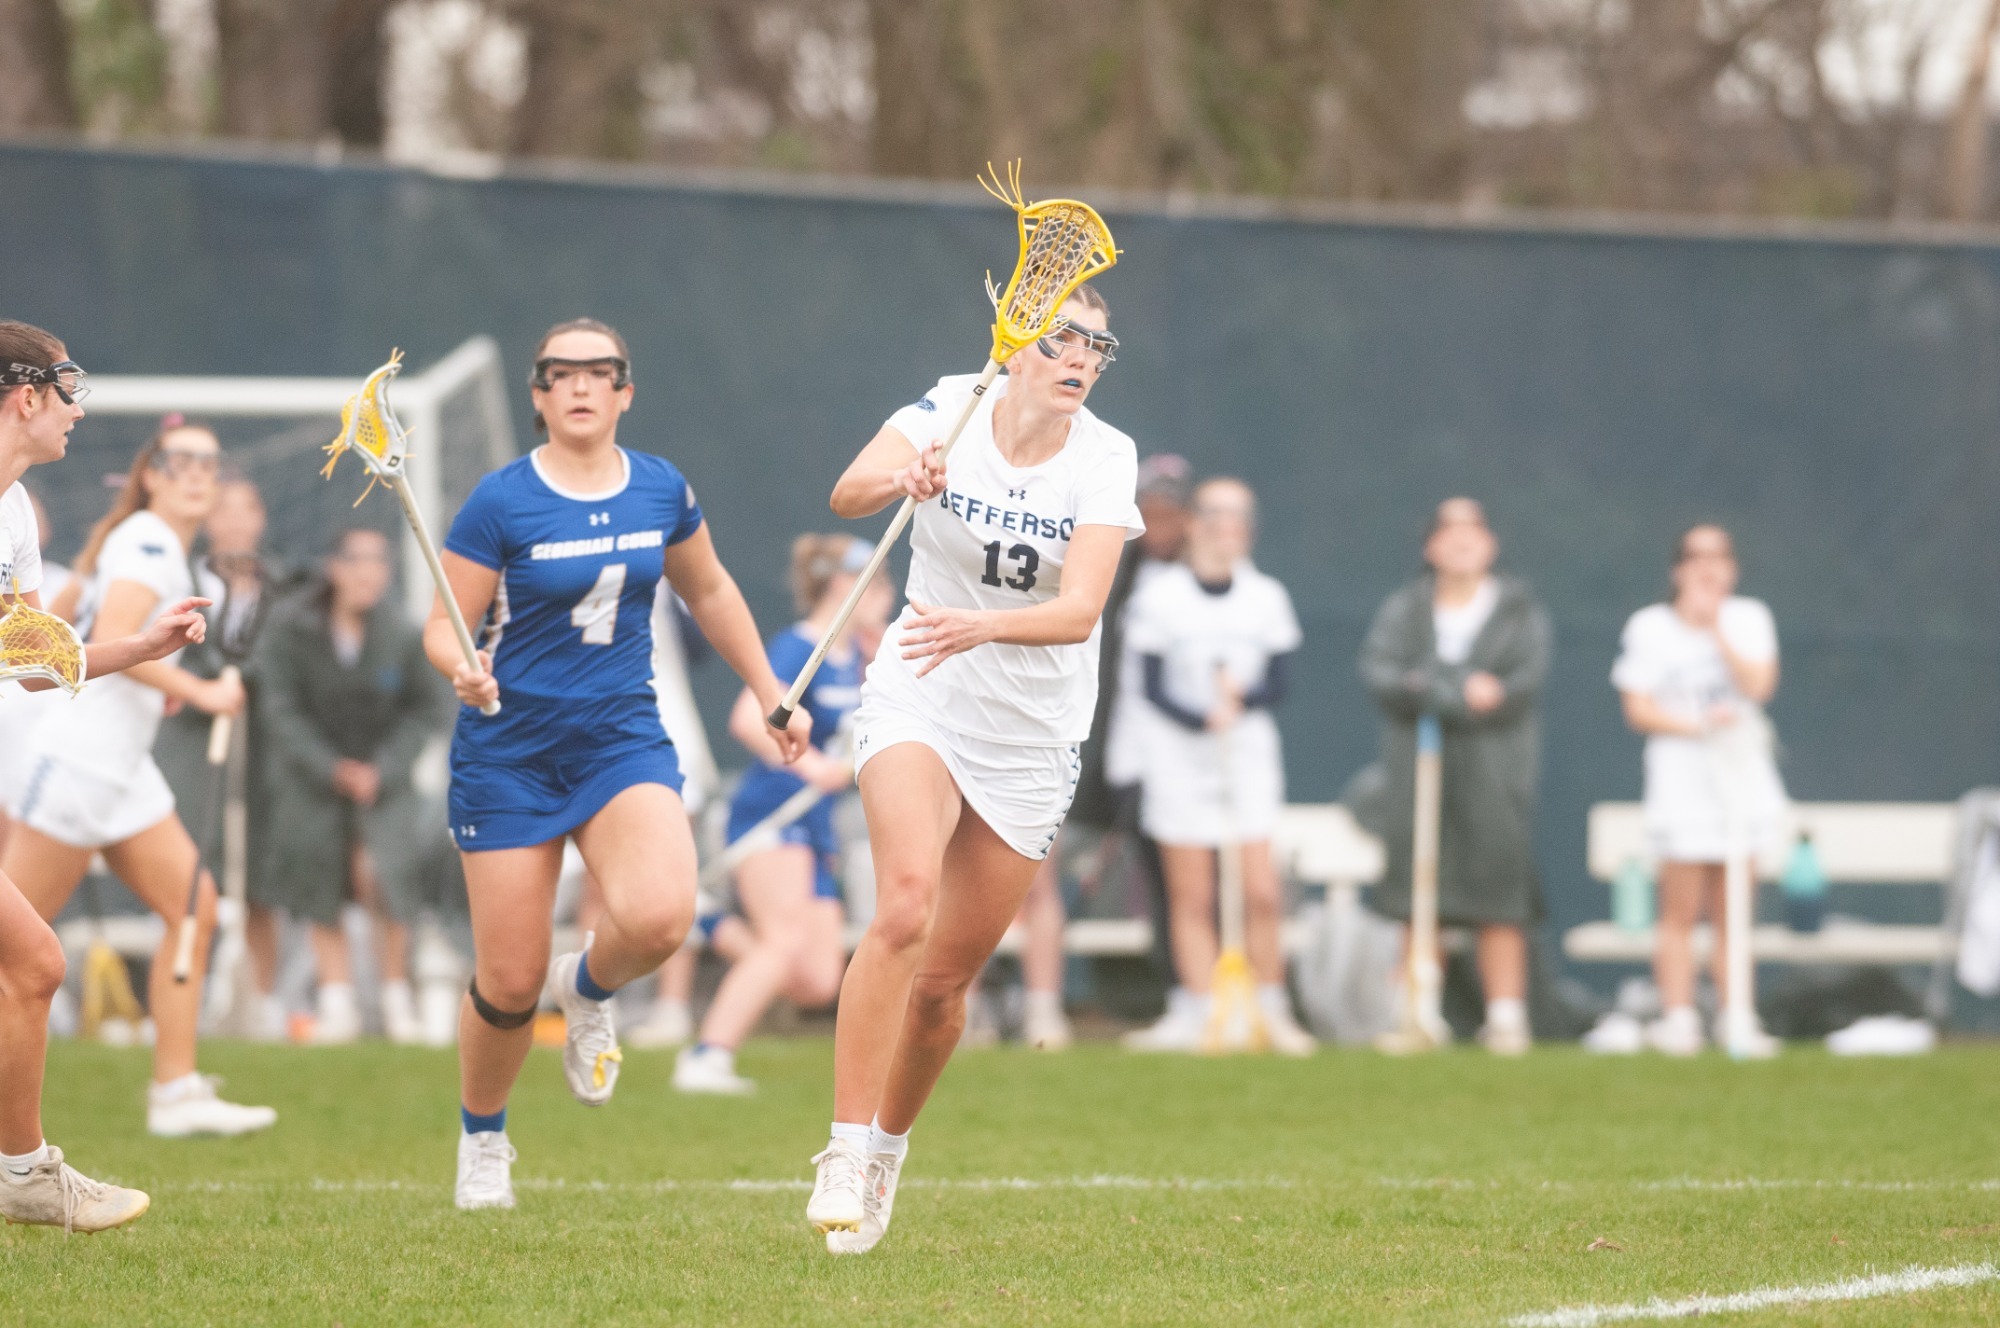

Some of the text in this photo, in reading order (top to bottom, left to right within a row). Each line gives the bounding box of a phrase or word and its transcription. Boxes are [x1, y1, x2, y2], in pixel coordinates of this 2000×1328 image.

[9, 362, 47, 378] STX
[940, 487, 1077, 542] JEFFERSO
[981, 540, 1039, 592] 13
[571, 563, 627, 645] 4
